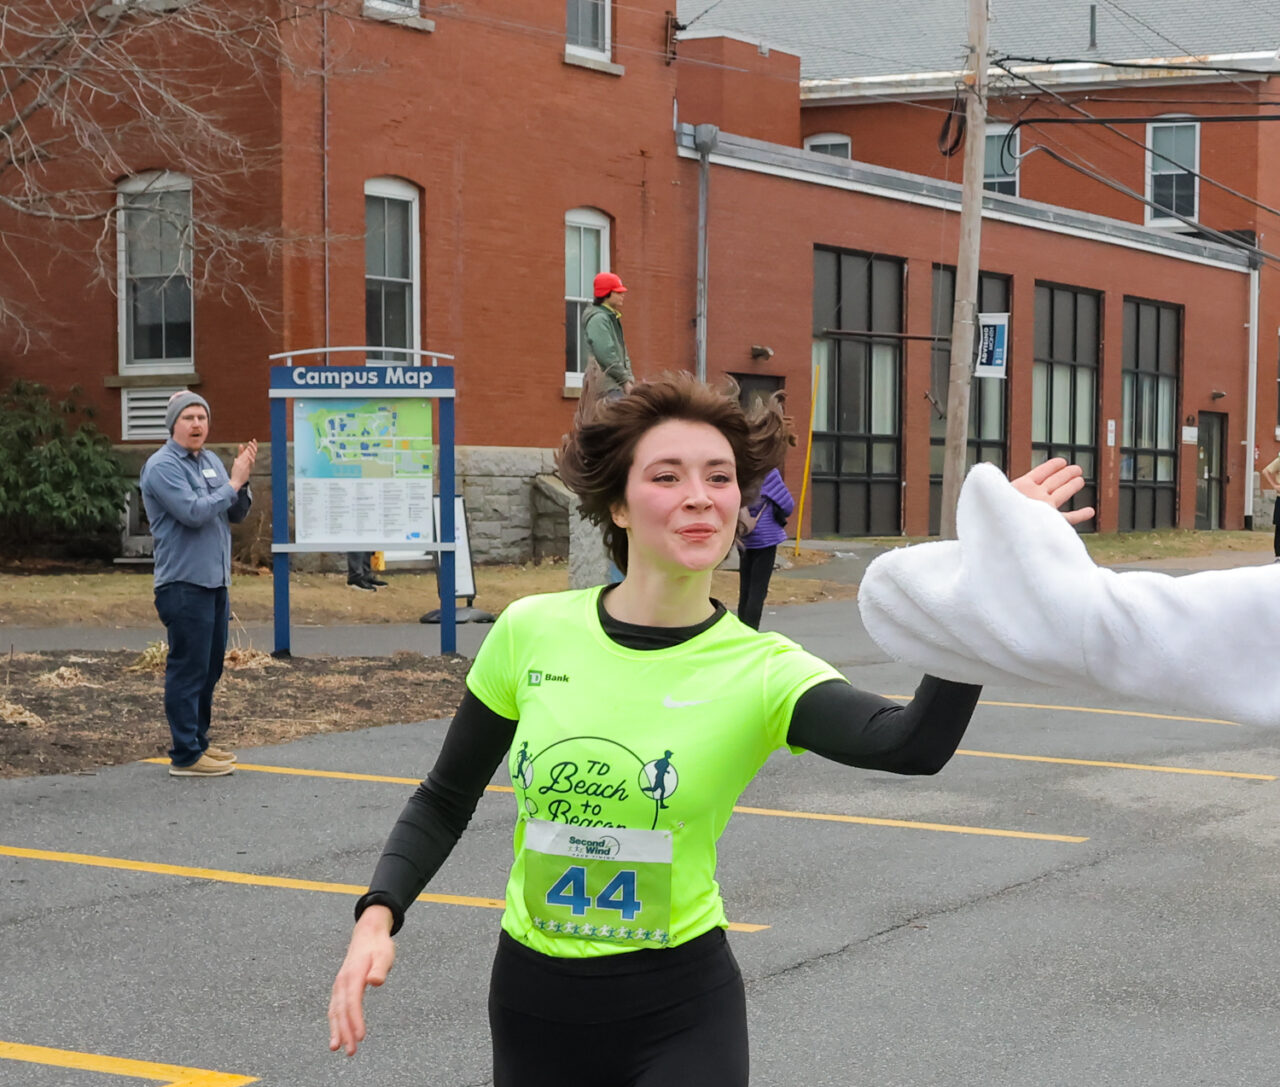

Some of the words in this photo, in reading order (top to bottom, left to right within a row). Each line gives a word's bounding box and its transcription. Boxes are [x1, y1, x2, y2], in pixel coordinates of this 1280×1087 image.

[292, 367, 379, 389] Campus
[385, 367, 433, 389] Map
[545, 673, 570, 684] Bank
[587, 760, 611, 776] TD
[538, 761, 629, 802] Beach
[581, 800, 602, 816] to
[569, 836, 605, 847] Second
[586, 846, 610, 855] Wind
[546, 865, 642, 921] 44
